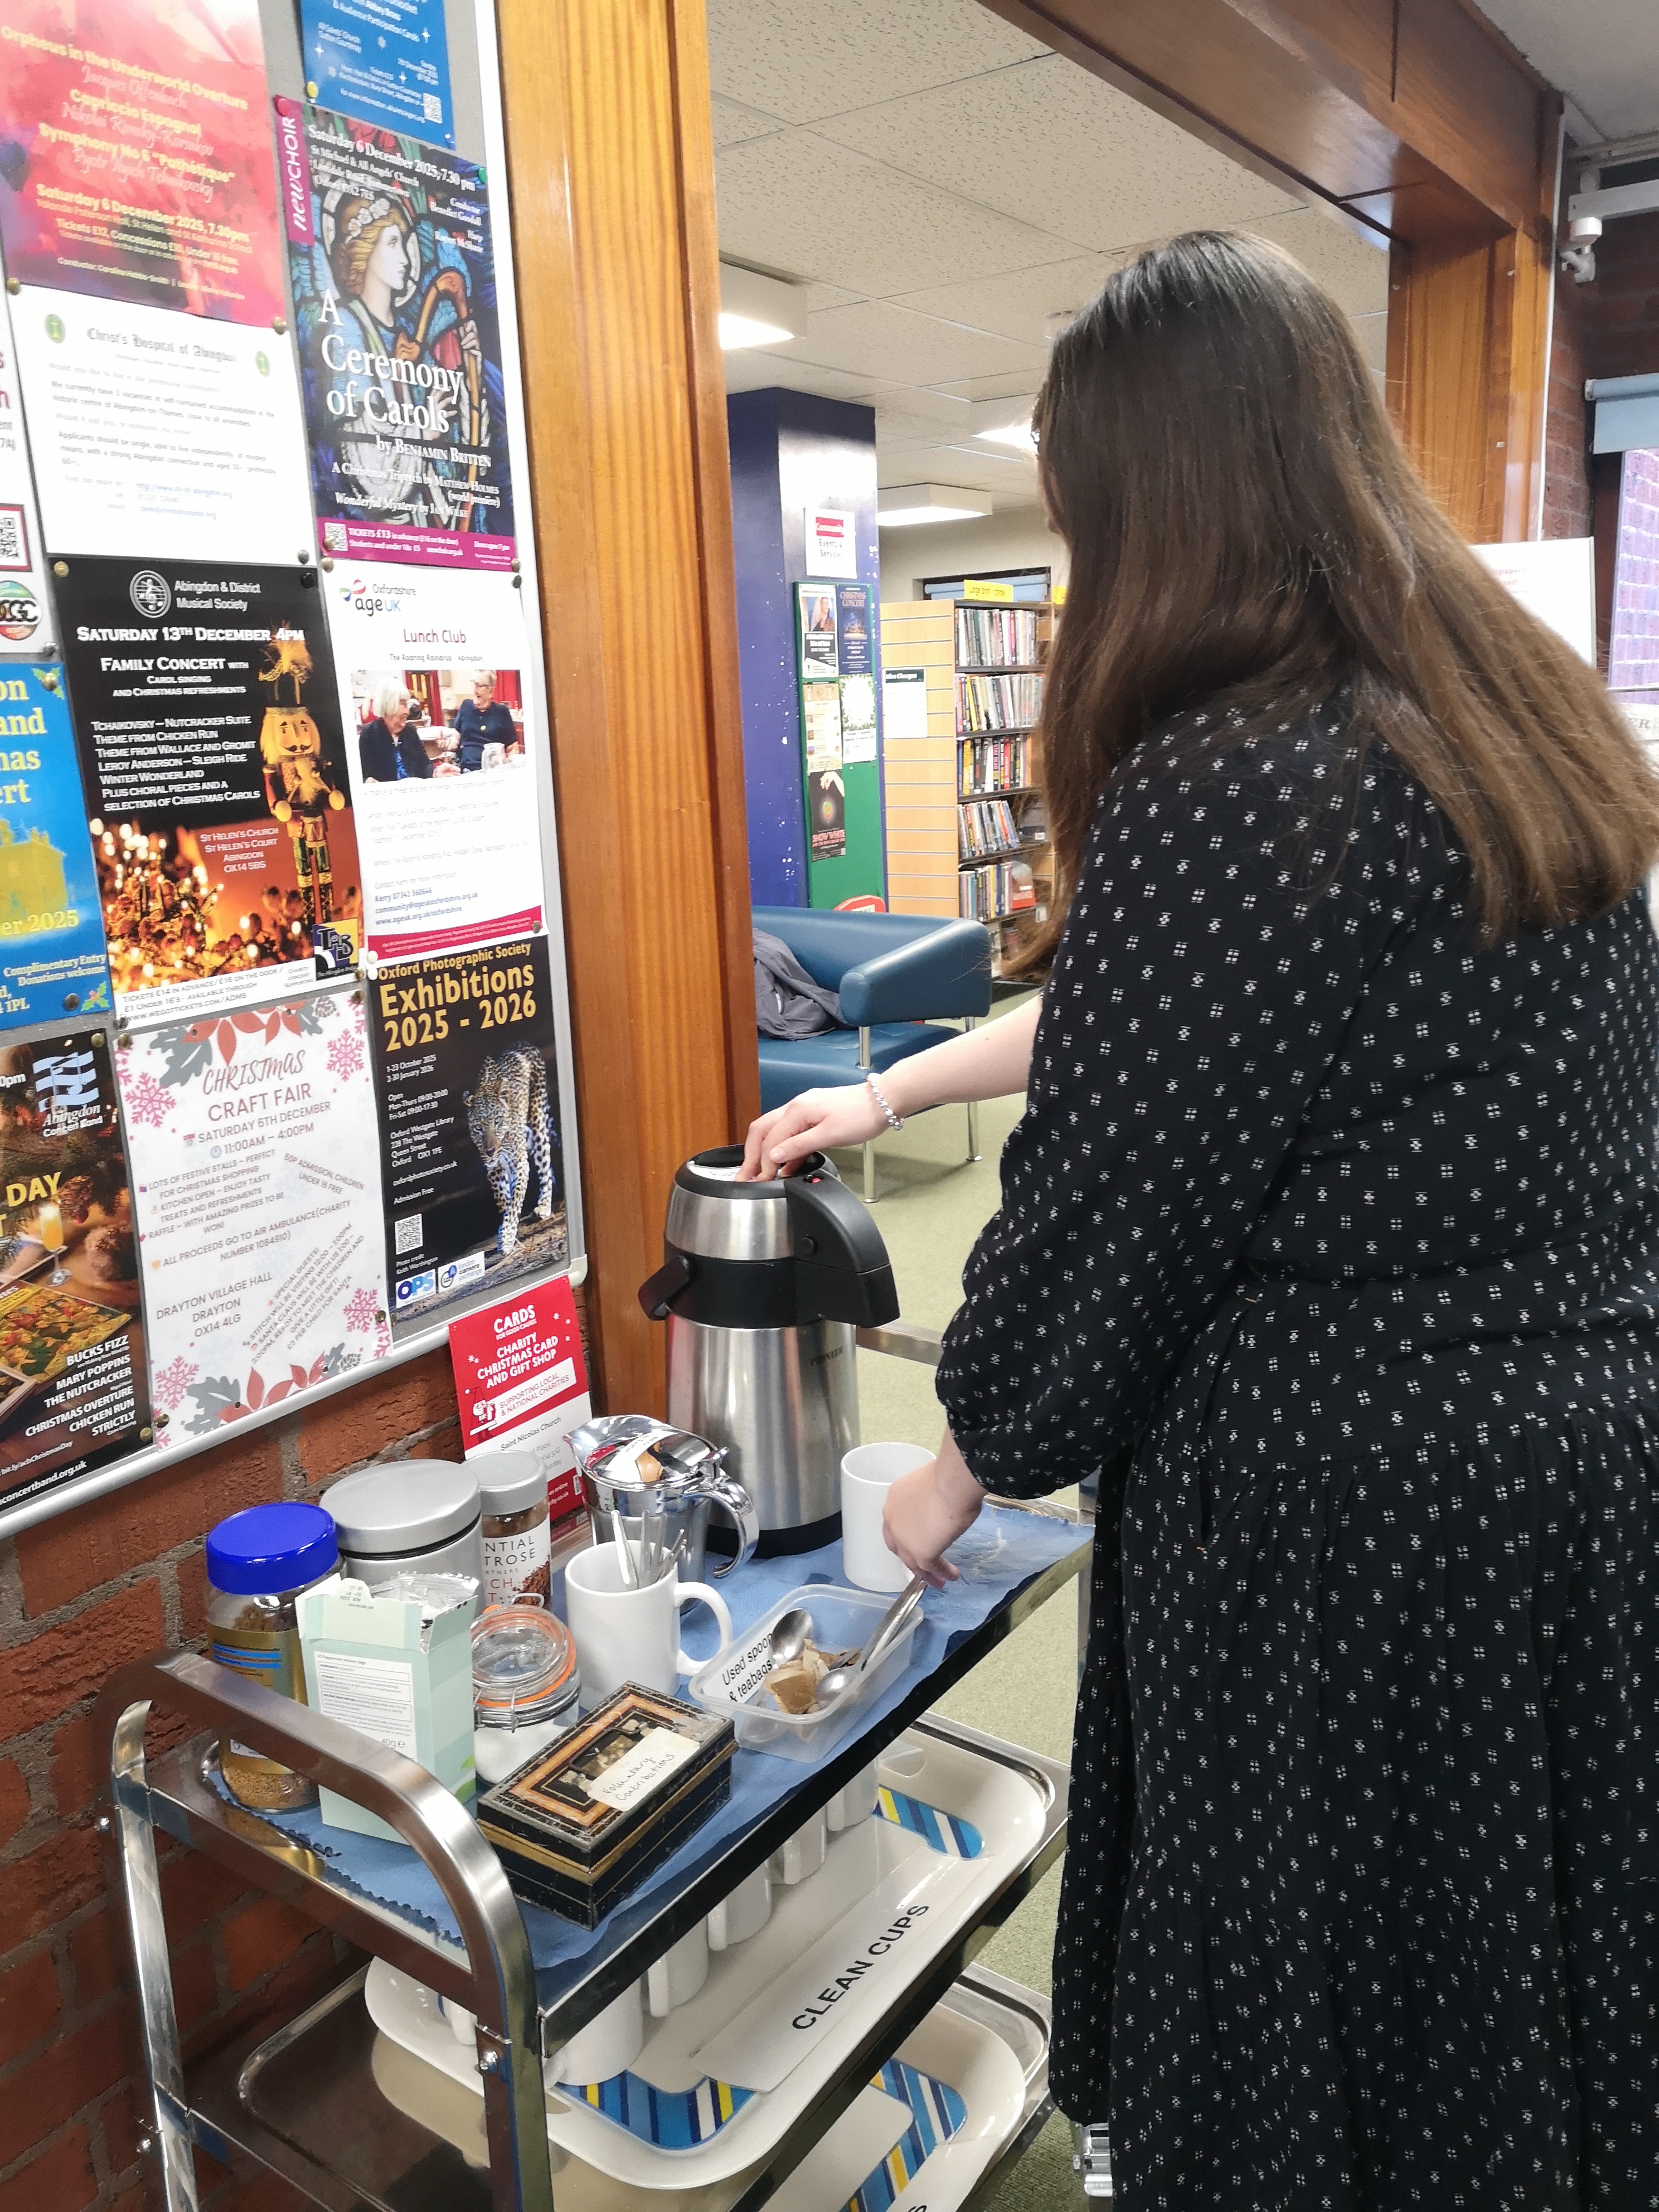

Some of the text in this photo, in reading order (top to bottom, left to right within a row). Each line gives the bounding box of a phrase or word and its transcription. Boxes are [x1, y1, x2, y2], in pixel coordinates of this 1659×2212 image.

[309, 125, 355, 152] Saturday
[356, 140, 365, 152] 6
[365, 144, 414, 169] December
[37, 184, 100, 211] Saturday
[111, 201, 174, 225] December
[318, 289, 344, 326] A
[322, 334, 464, 405] Ceremony
[327, 381, 449, 433] of Carols
[376, 435, 492, 467] by BENJAMIN BRITTEN
[174, 581, 261, 594] Abingdon & District
[372, 584, 416, 596] Oxfordshire
[176, 598, 248, 612] Musical Society
[355, 597, 401, 617] age UK
[77, 627, 158, 641] SATURDAY
[195, 627, 271, 641] DECEMBER
[275, 628, 304, 641] 4PM
[403, 628, 467, 643] Lunch Club
[101, 657, 155, 671] FAMILY
[157, 657, 226, 670] CONCERT
[147, 676, 177, 684] CAROL
[164, 717, 225, 728] NUTCRACKER
[225, 716, 251, 725] SUITE
[93, 730, 219, 745] THEME FROM CHICKEN RUN
[99, 770, 205, 785] WINTER WONDERLAND
[212, 831, 246, 841] HELEN'S
[246, 827, 279, 837] CHURCH
[375, 894, 393, 903] Kerry
[28, 909, 79, 932] 2025
[3, 954, 107, 977] Complimentary Entry
[378, 942, 531, 981] Oxford Photographic Society
[17, 966, 106, 987] Donations welcome
[379, 964, 535, 1017] Exhibitions
[384, 1008, 449, 1052] 2025
[479, 990, 536, 1030] 2026
[42, 1104, 101, 1127] Abingdon
[208, 1083, 312, 1122] CRAFT FAIR
[43, 1115, 103, 1138] Concert Band
[198, 1101, 331, 1143] SATURDAY 6TH DECEMBER
[390, 1117, 454, 1139] Oxford Westgate Library
[224, 1136, 265, 1154] 11:00AM
[278, 1123, 314, 1140] 4:00PM
[391, 1143, 427, 1158] Queen Street
[6, 1171, 62, 1207] DAY
[394, 1192, 421, 1205] Admission
[156, 1272, 273, 1320] DRAYTON VILLAGE HALL
[397, 1272, 434, 1300] OPS
[192, 1298, 242, 1323] DRAYTON
[494, 1304, 536, 1333] CARDS
[195, 1313, 242, 1338] OX14 4LG
[66, 1335, 129, 1366] BUCKS FIZZ
[477, 1336, 558, 1379] CHRISTMAS CARD
[497, 1332, 537, 1358] CHARITY
[56, 1354, 131, 1390] MARY POPPINS
[486, 1348, 556, 1389] AND GIFT SHOP
[44, 1367, 132, 1408] THE NUTCRACKER
[499, 1372, 560, 1409] SUPPORTING LOCAL
[507, 1393, 539, 1414] NATIONAL
[539, 1375, 570, 1396] CHARITIES
[25, 1385, 134, 1437] CHRISTMAS OVERTURE
[69, 1398, 134, 1432] CHICKEN RUN
[91, 1410, 137, 1436] STRICTLY
[501, 1416, 561, 1451] Saint Nicolas Church
[484, 1548, 536, 1566] TROSE
[485, 1536, 534, 1552] NTIAL
[722, 1633, 773, 1685] Used spoon
[729, 1691, 738, 1702] &
[602, 1757, 656, 1794] Voluntary
[616, 1753, 675, 1801] Contributions
[792, 1905, 929, 2029] CLEAN CUPS
